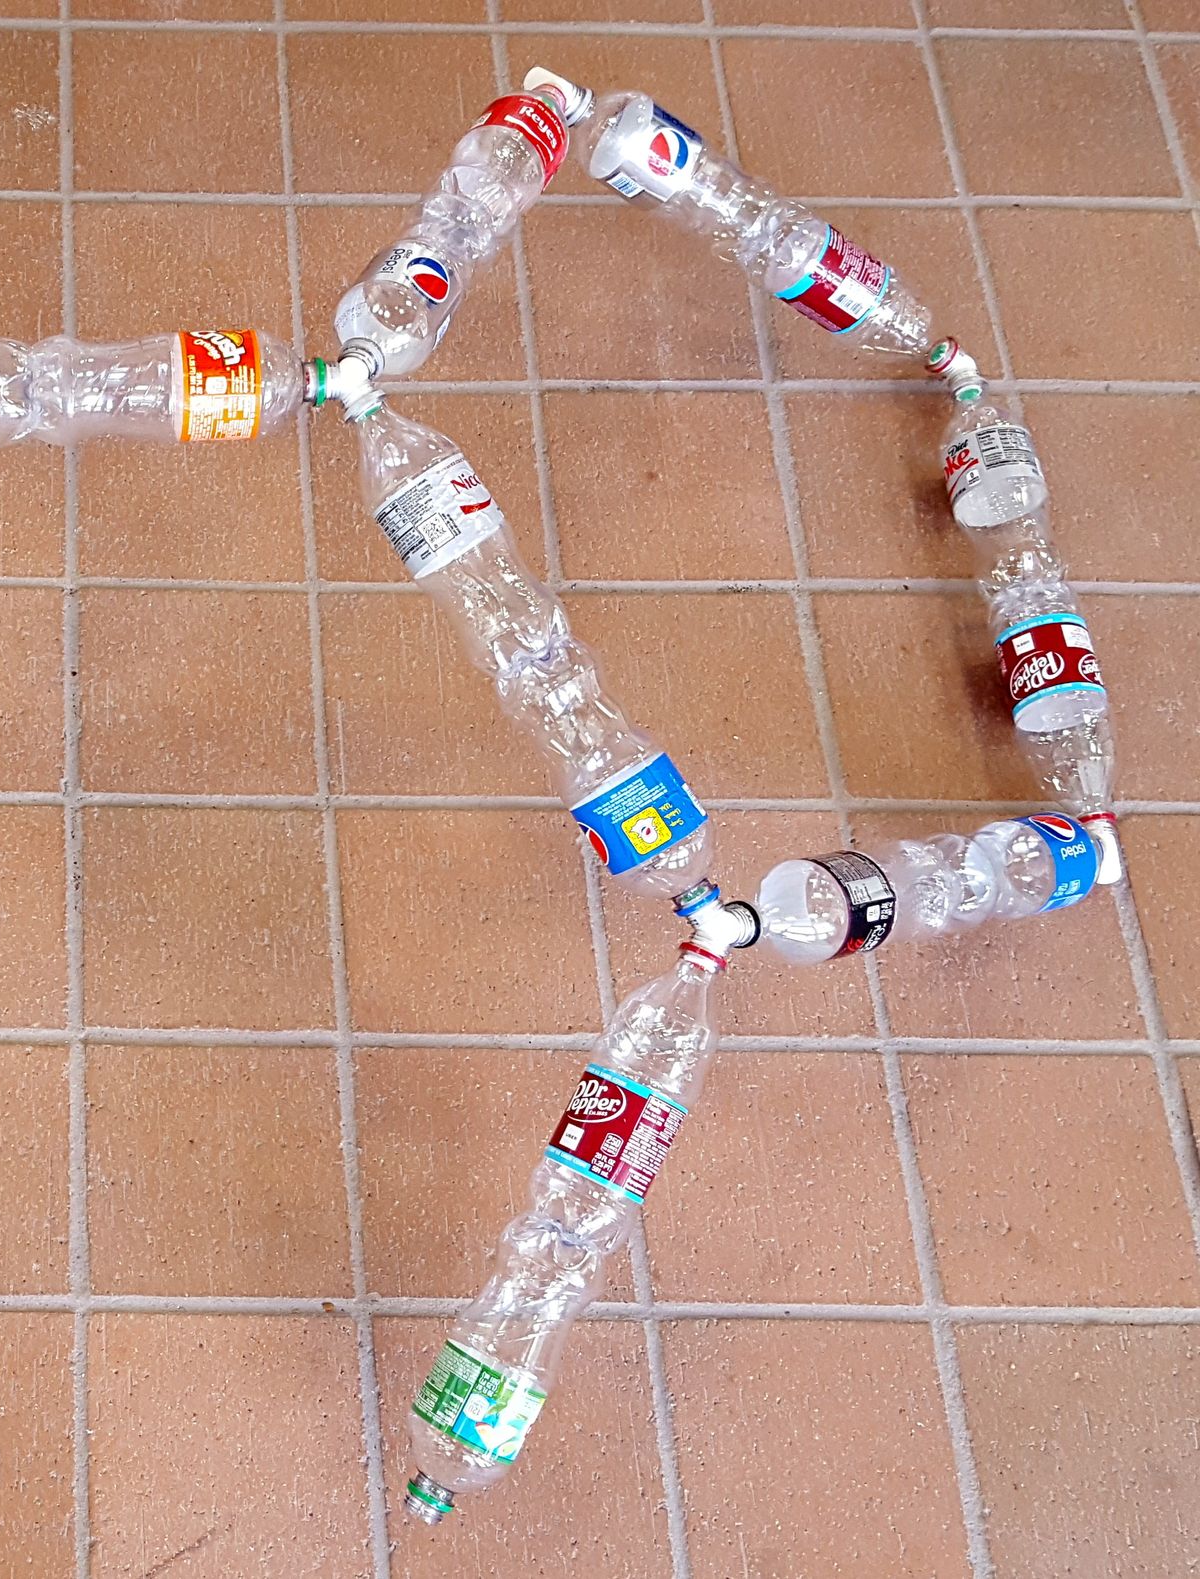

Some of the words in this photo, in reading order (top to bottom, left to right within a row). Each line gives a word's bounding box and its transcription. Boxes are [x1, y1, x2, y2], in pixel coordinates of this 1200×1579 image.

[519, 106, 557, 149] Reyes
[1012, 651, 1059, 695] Pepper
[1024, 672, 1046, 693] Dr
[1060, 841, 1087, 860] pepsi
[584, 1079, 609, 1097] Dr
[606, 1135, 620, 1148] 250
